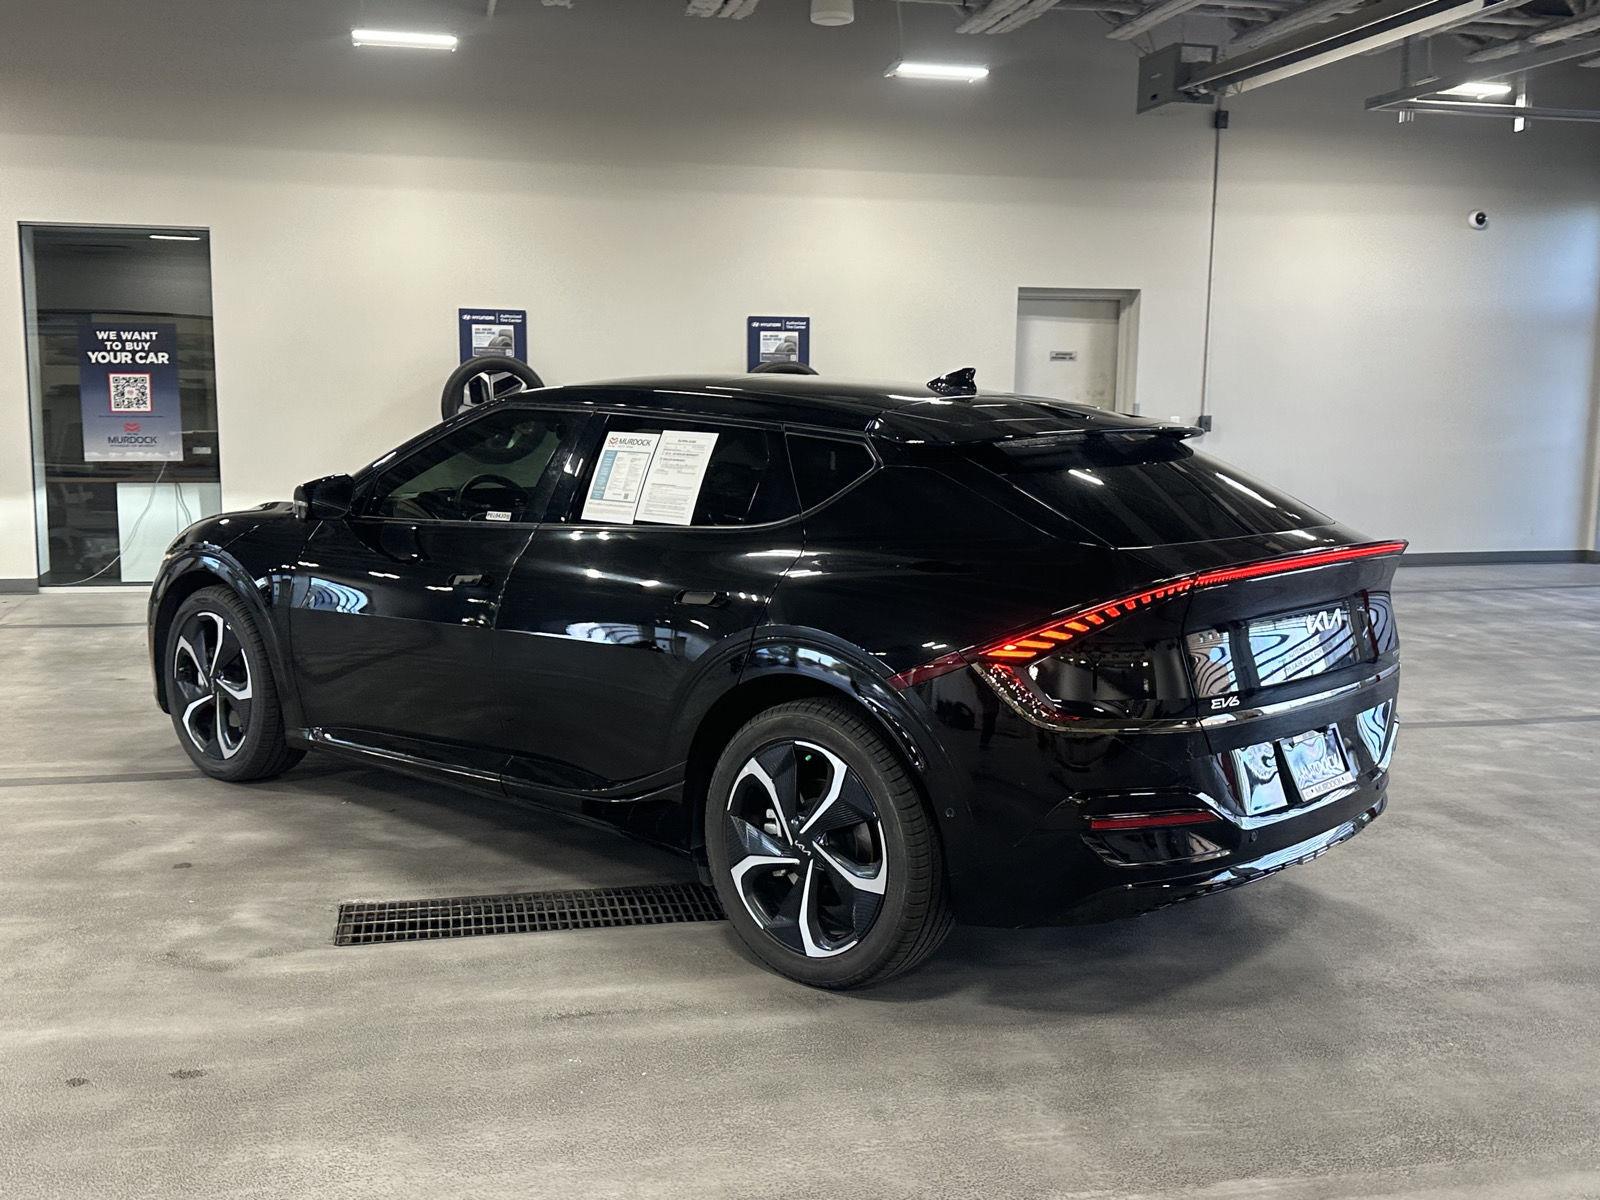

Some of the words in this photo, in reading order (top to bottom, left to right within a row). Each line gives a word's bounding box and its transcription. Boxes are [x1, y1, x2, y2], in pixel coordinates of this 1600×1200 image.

[96, 331, 117, 340] WE
[120, 331, 158, 340] WANT
[104, 341, 122, 350] TO
[125, 341, 151, 350] BUY
[87, 351, 133, 363] YOUR
[135, 352, 169, 363] CAR
[107, 436, 157, 444] MURDOCK
[619, 437, 652, 447] MURDOCK
[1306, 608, 1342, 634] KIA
[1211, 695, 1240, 709] EV6
